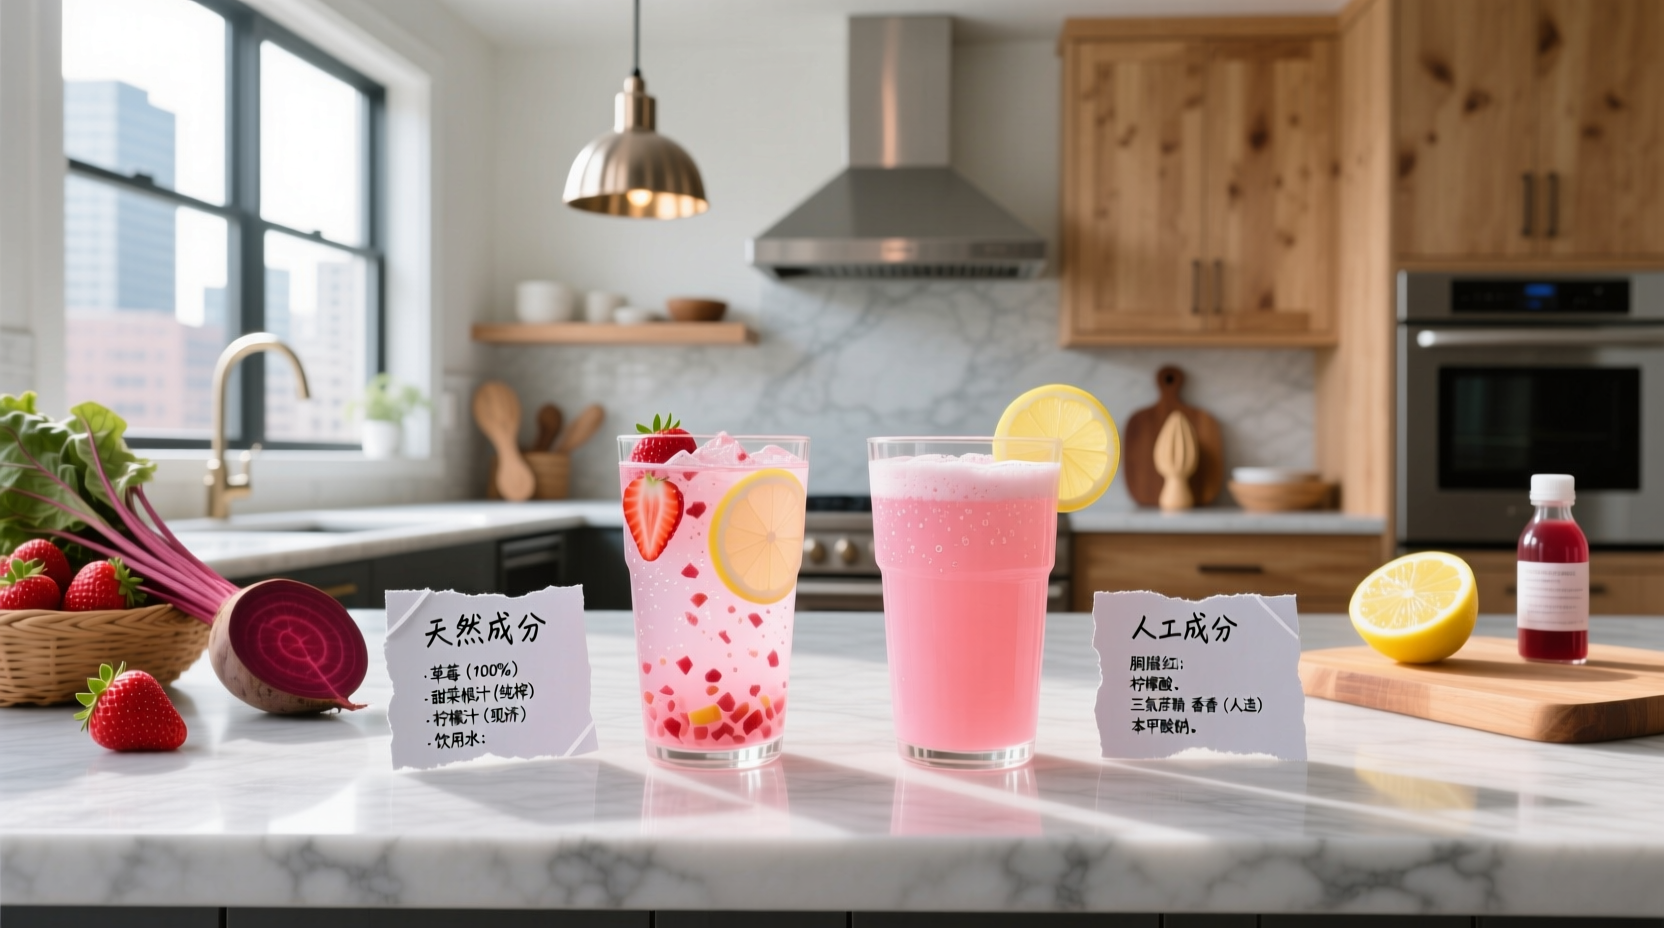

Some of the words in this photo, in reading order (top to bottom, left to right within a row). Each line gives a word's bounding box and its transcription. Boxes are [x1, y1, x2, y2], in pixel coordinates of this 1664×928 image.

[425, 611, 546, 648] 天然成分
[1132, 612, 1238, 644] 人工成分
